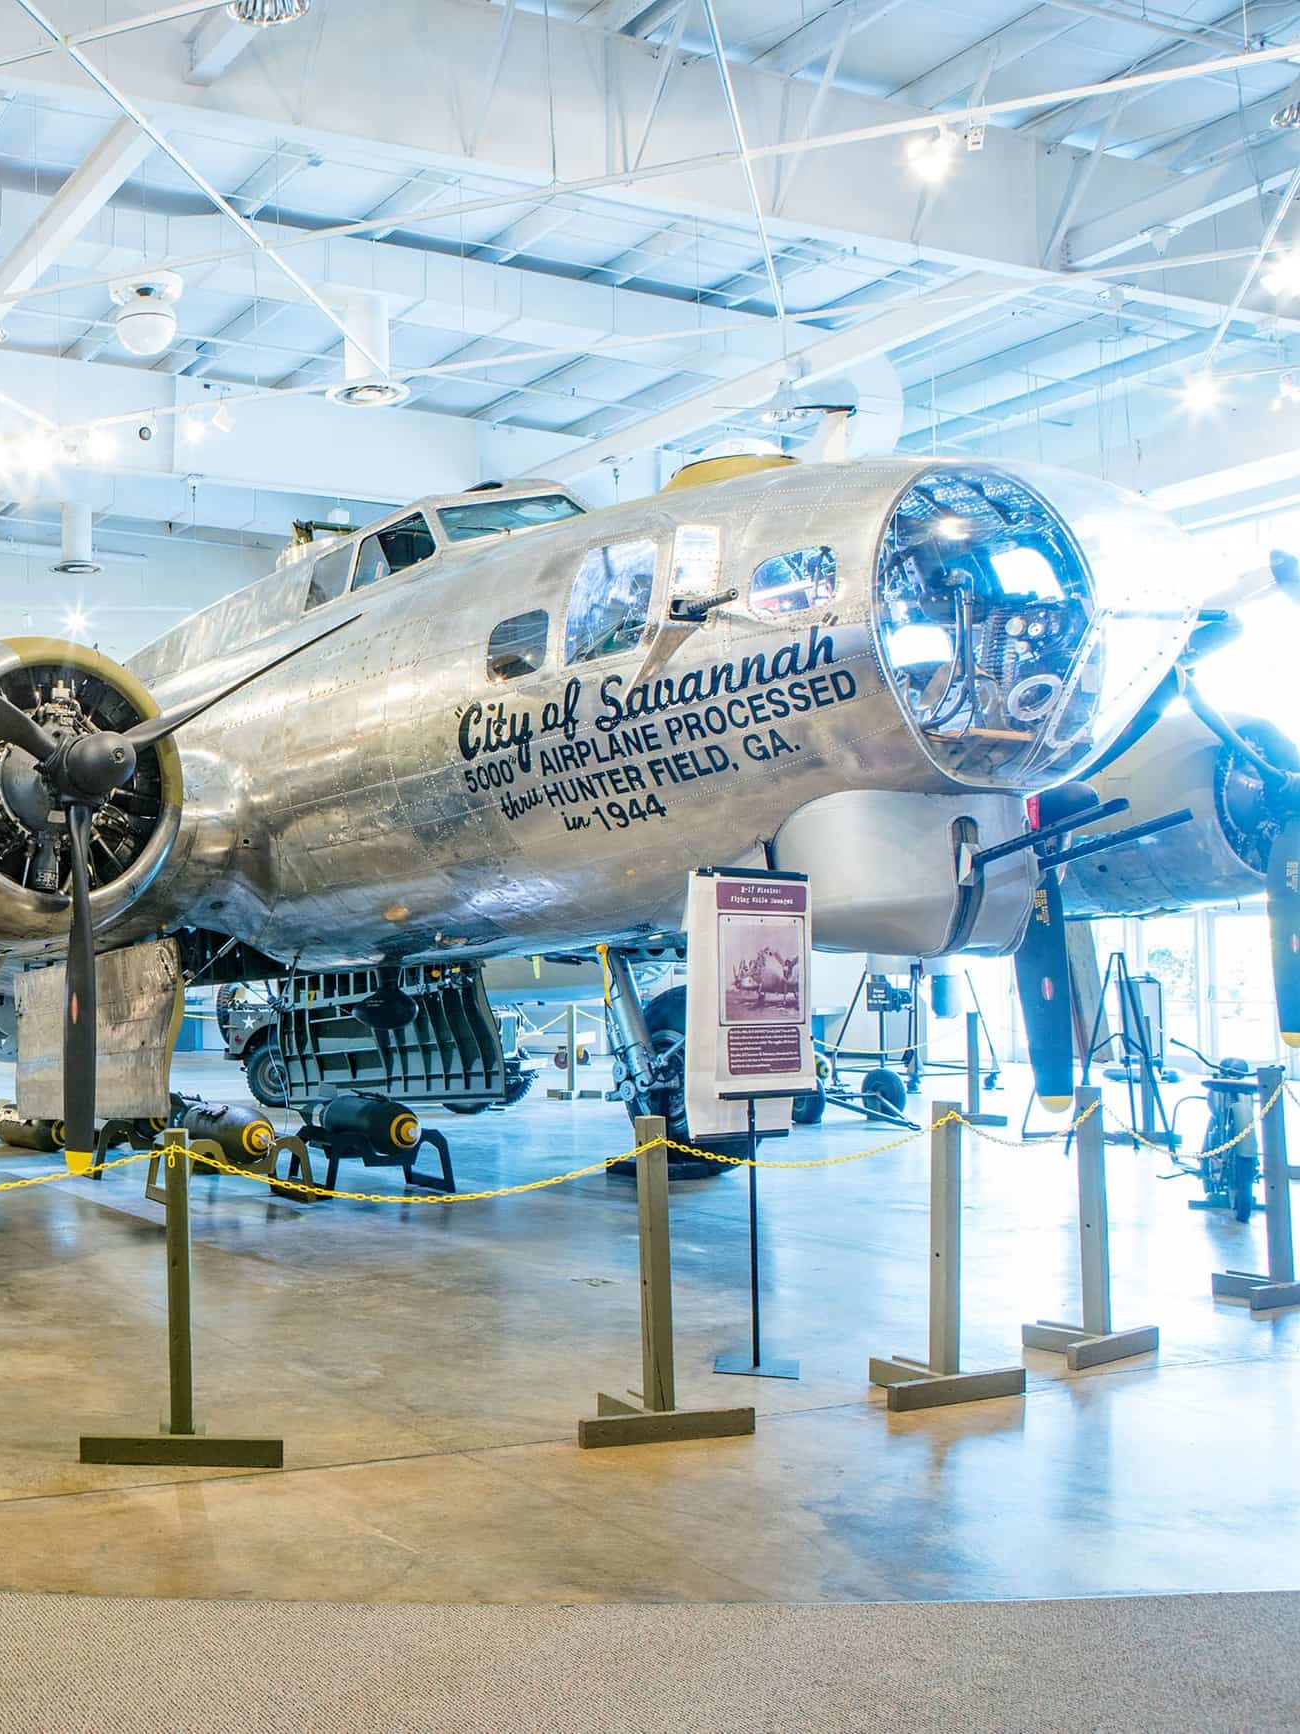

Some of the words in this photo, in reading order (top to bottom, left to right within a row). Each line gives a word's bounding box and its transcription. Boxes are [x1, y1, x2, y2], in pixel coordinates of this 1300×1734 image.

[540, 723, 662, 776] AIRPLANE
[665, 669, 857, 746] PROCESSED
[541, 677, 579, 741] of
[501, 789, 543, 820] thru
[543, 764, 647, 807] HUNTER
[647, 744, 740, 787] FIELD,
[742, 728, 801, 761] GA.
[560, 811, 591, 831] in
[592, 793, 667, 831] 1944
